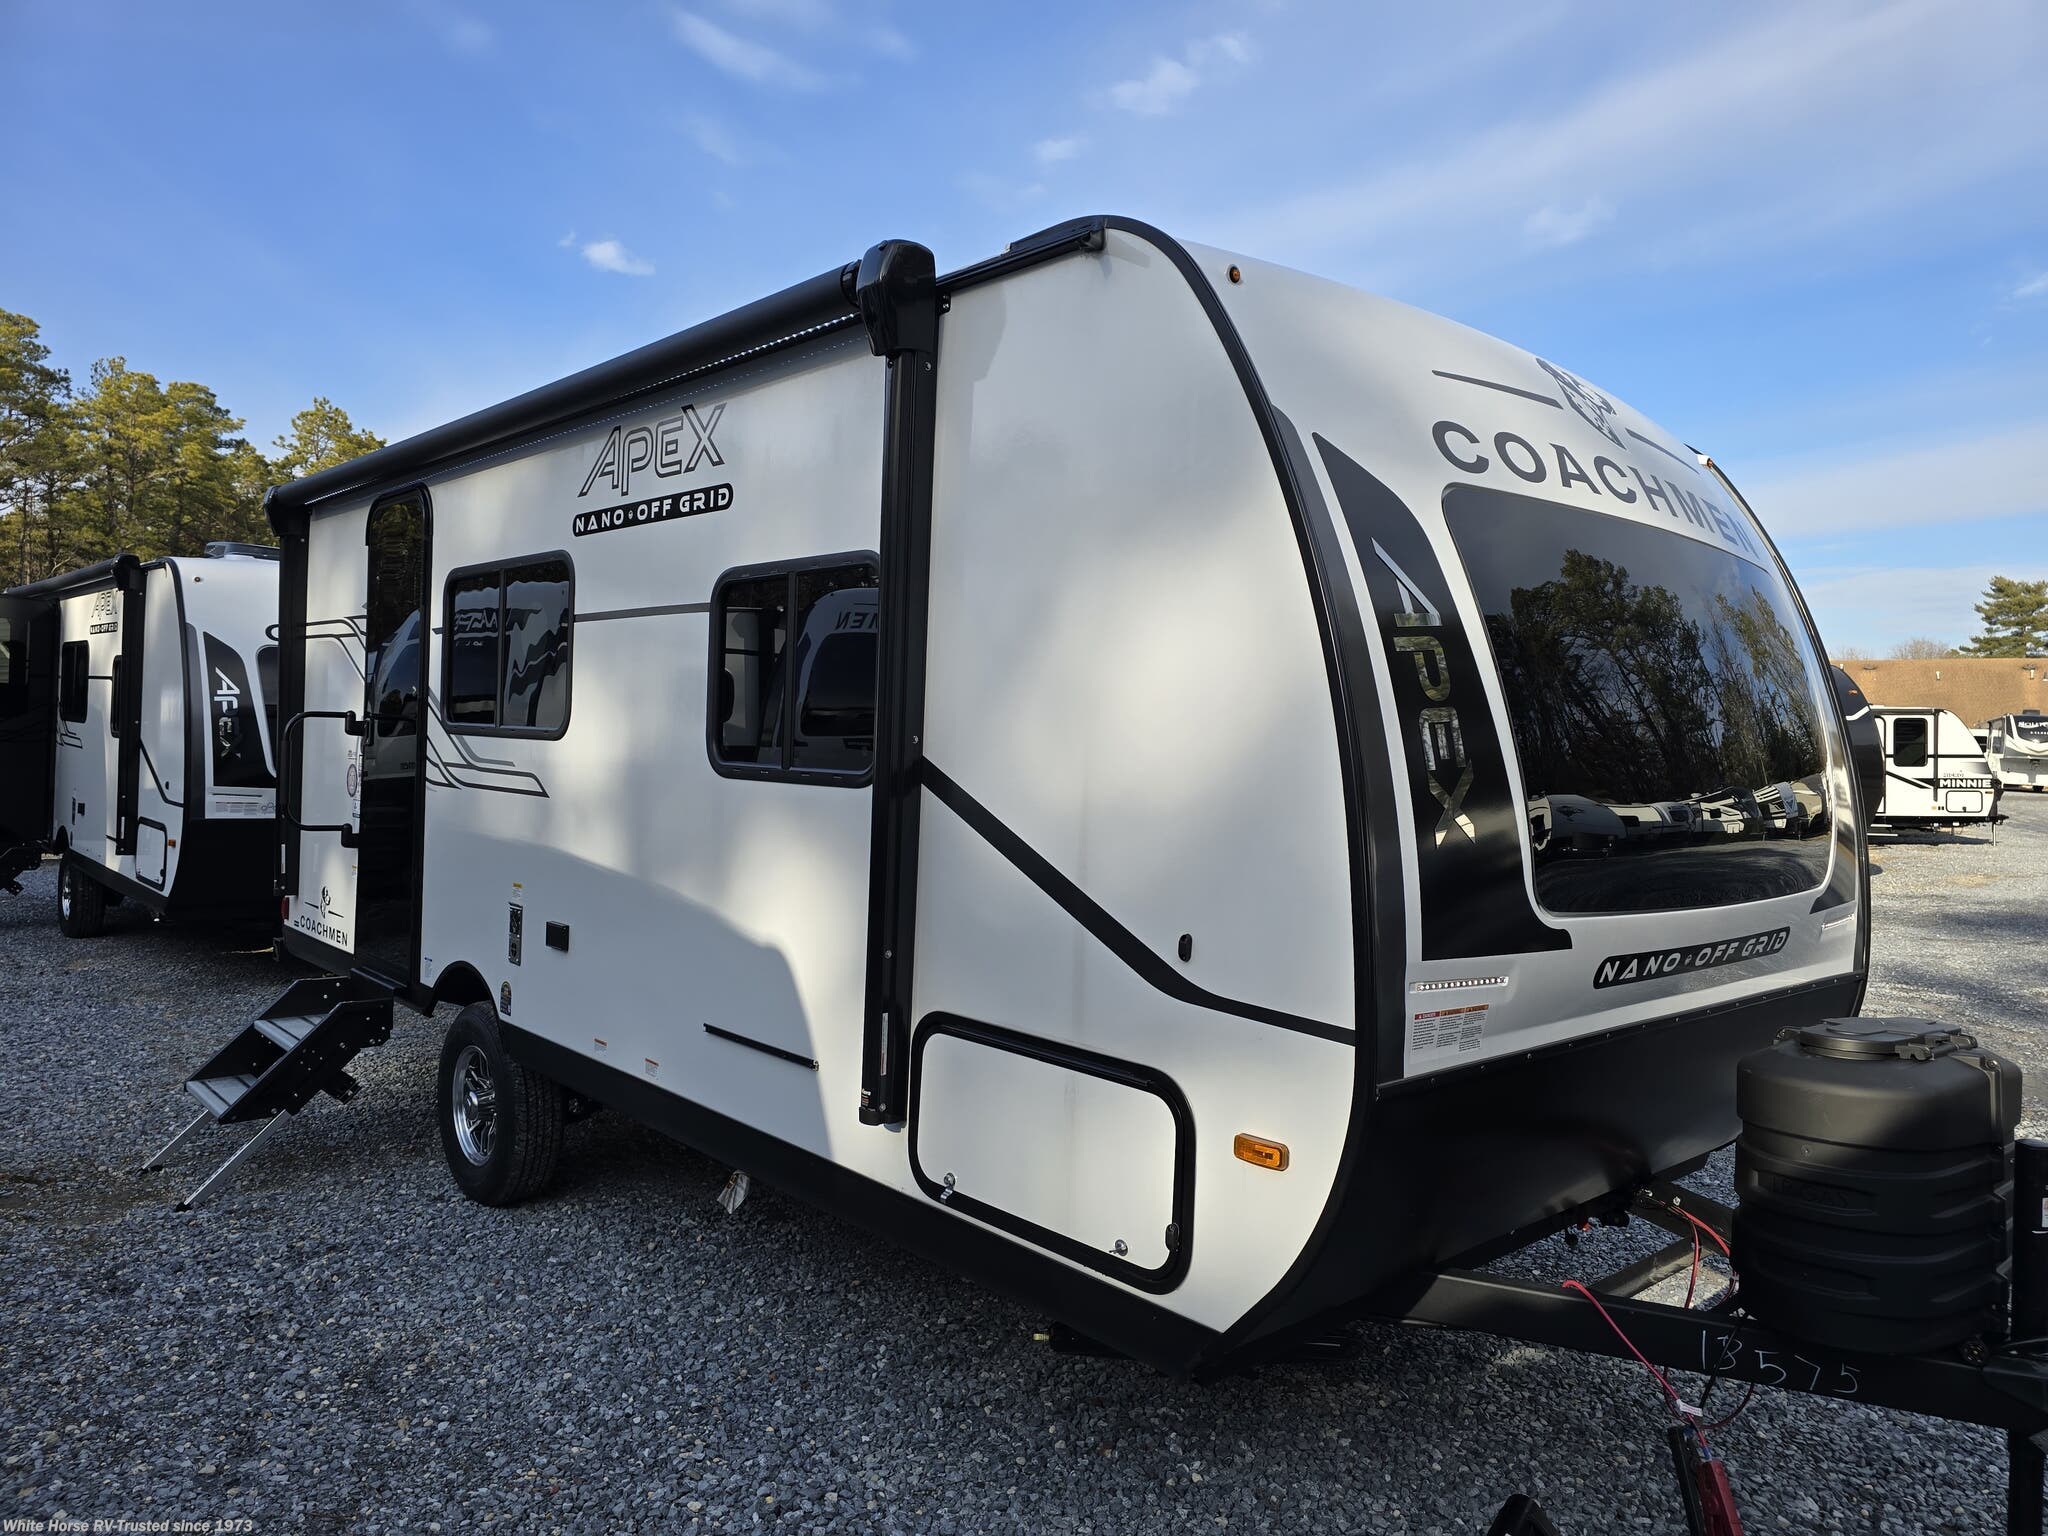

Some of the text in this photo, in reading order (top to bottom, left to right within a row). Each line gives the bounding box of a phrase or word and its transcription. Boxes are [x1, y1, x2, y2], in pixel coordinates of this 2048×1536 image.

[577, 402, 727, 497] APEX
[575, 487, 730, 533] NANO OFF GRID
[1431, 420, 1760, 560] COACHMEN
[1370, 537, 1476, 849] APEX
[1939, 778, 1992, 788] MINNIE
[300, 914, 348, 947] COACHMEN
[1599, 931, 1787, 983] NANO OFF GRID
